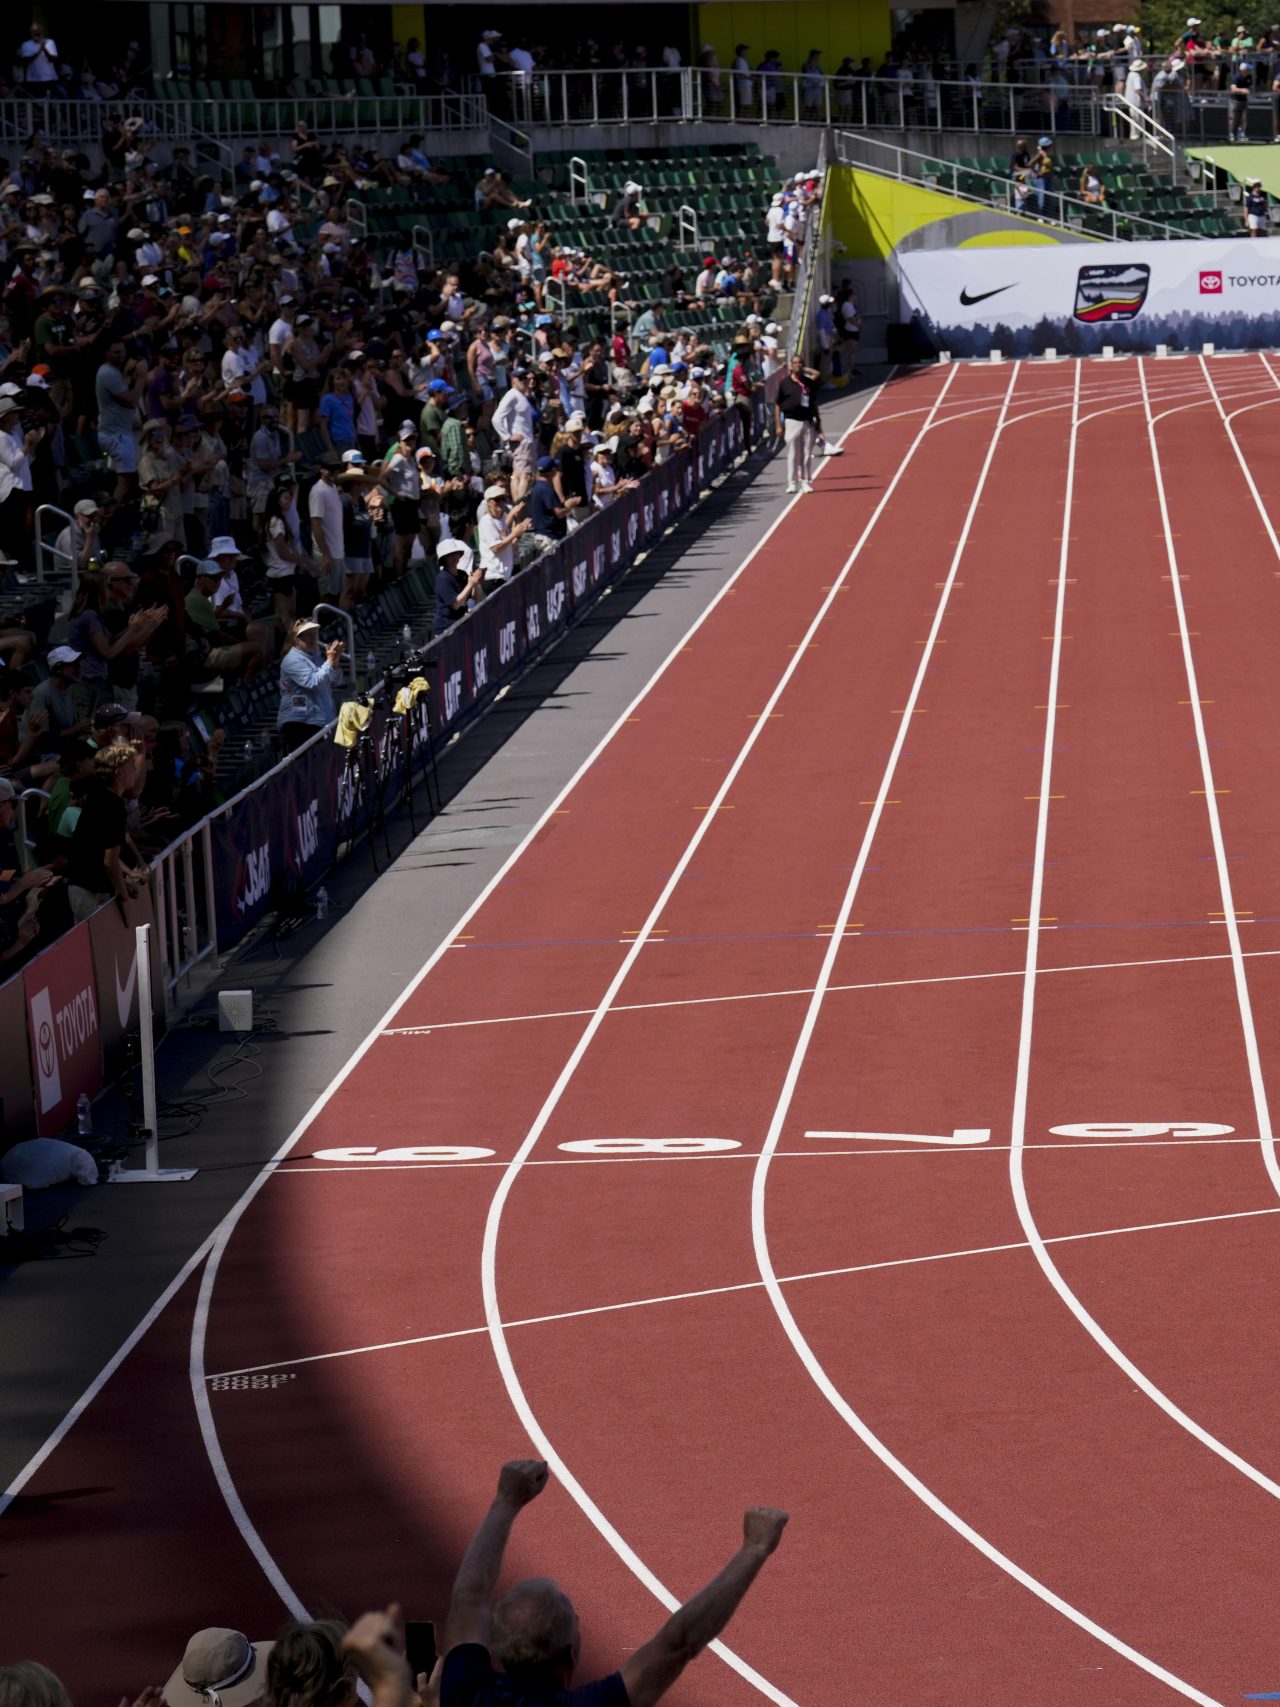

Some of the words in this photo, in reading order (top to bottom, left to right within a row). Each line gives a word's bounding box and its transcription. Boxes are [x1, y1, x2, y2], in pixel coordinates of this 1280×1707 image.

[56, 985, 98, 1061] TOYOTA
[804, 1128, 991, 1145] 7
[557, 1137, 743, 1154] 8
